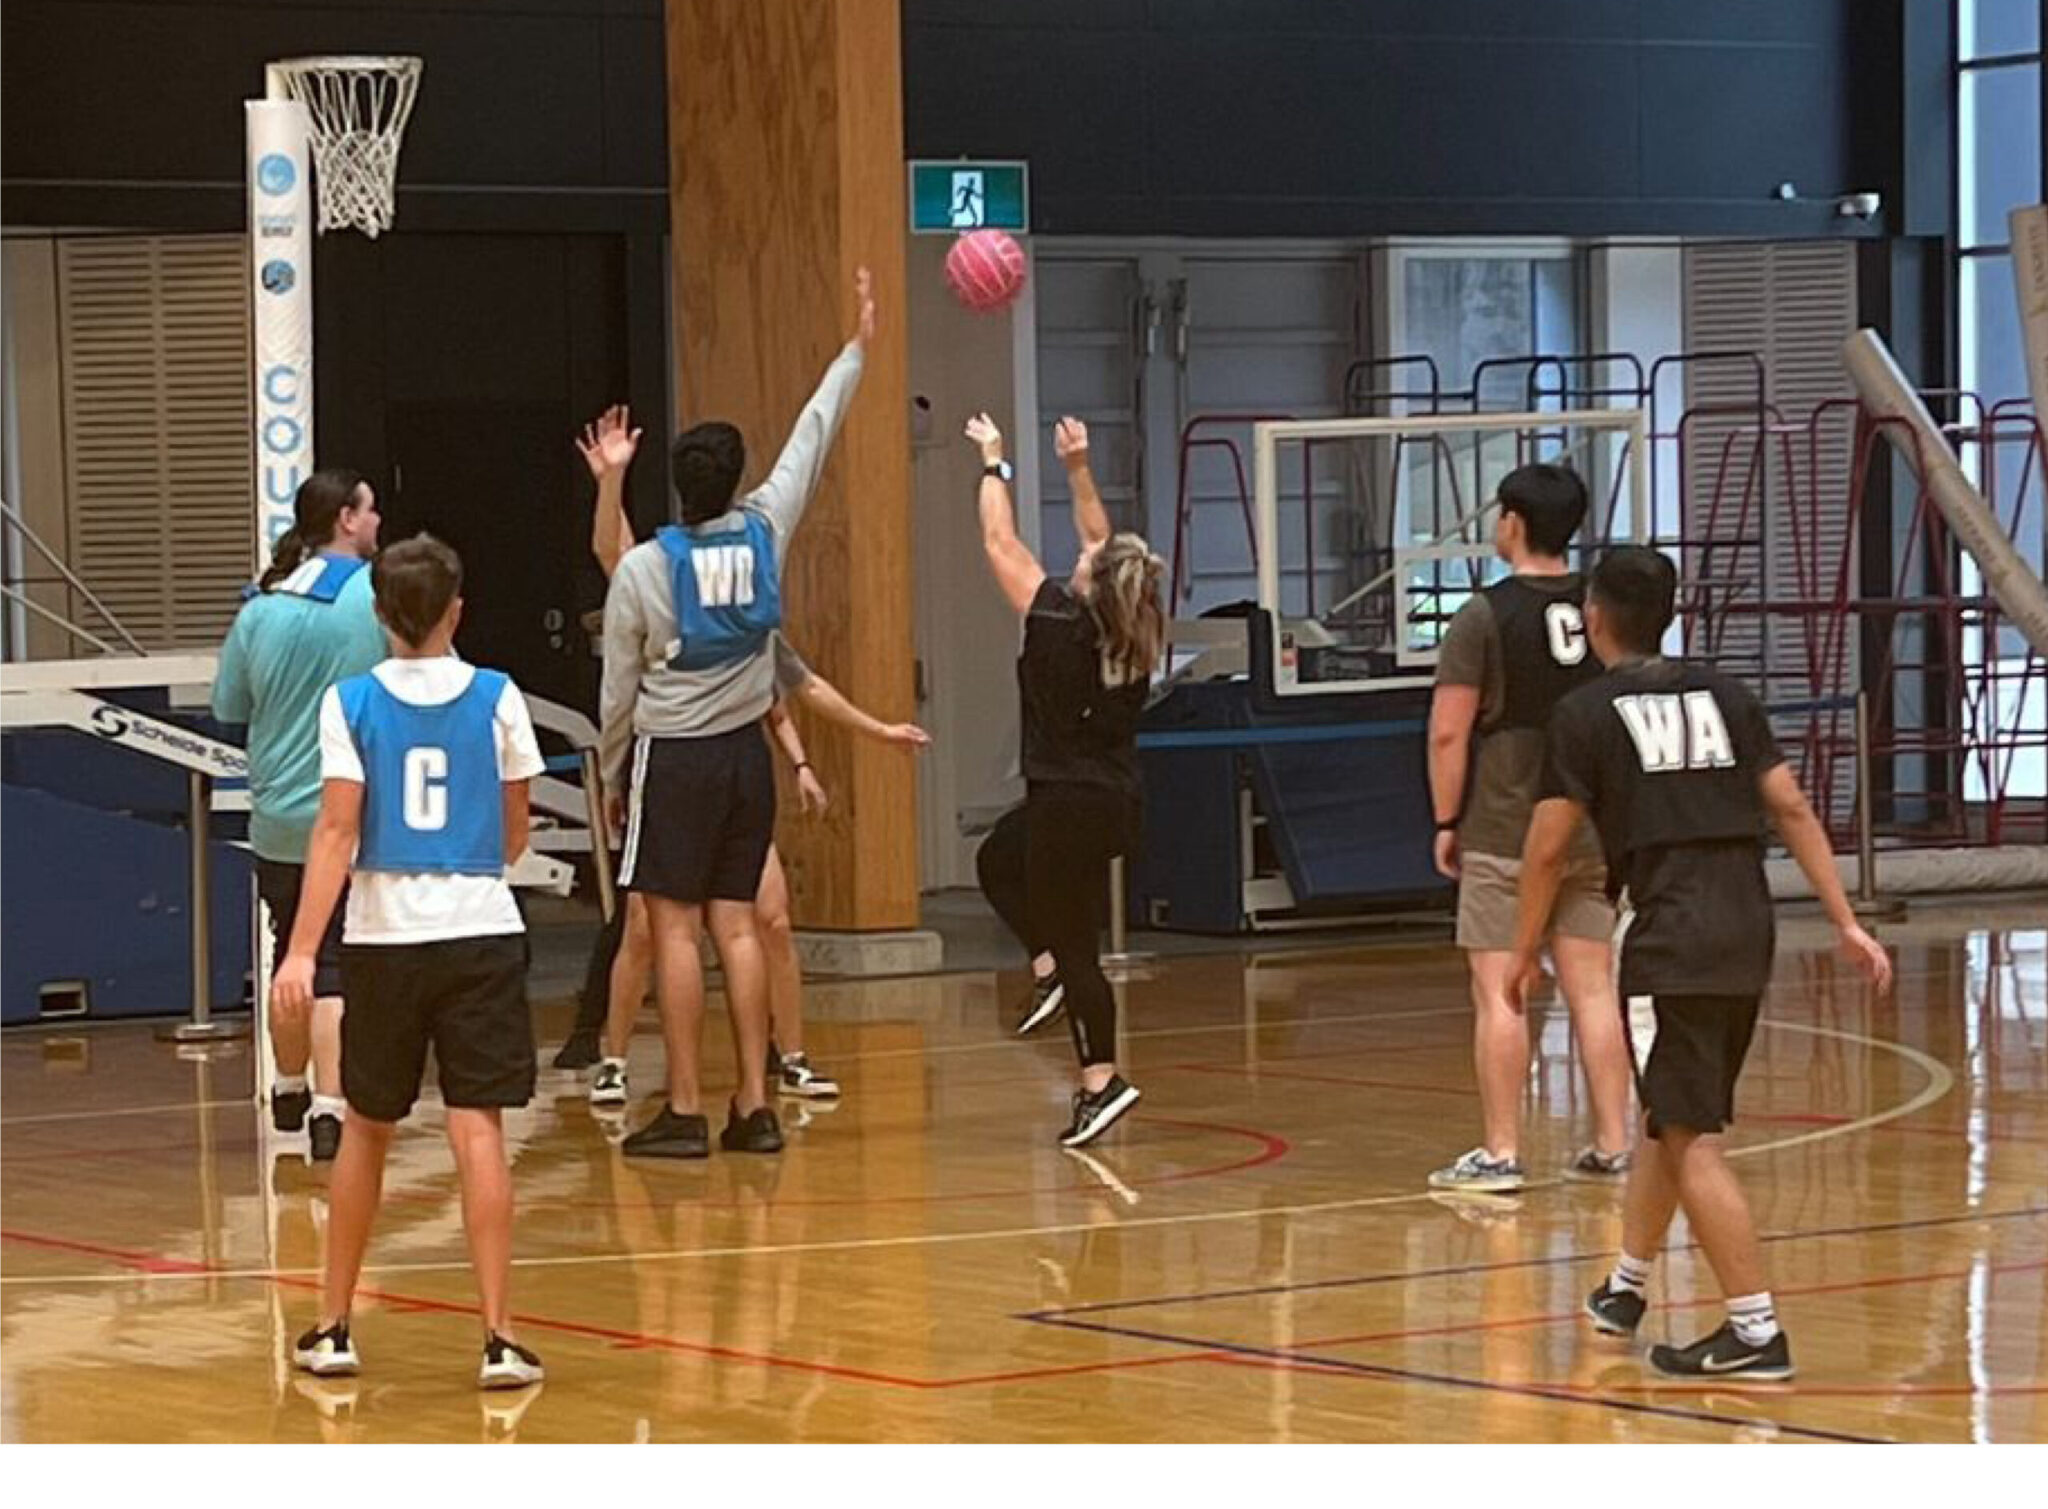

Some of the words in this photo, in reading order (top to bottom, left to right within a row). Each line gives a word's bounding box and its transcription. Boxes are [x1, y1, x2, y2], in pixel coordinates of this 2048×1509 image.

[691, 545, 754, 606] WD
[1545, 602, 1588, 666] C
[1612, 690, 1736, 772] WA
[403, 746, 448, 831] C
